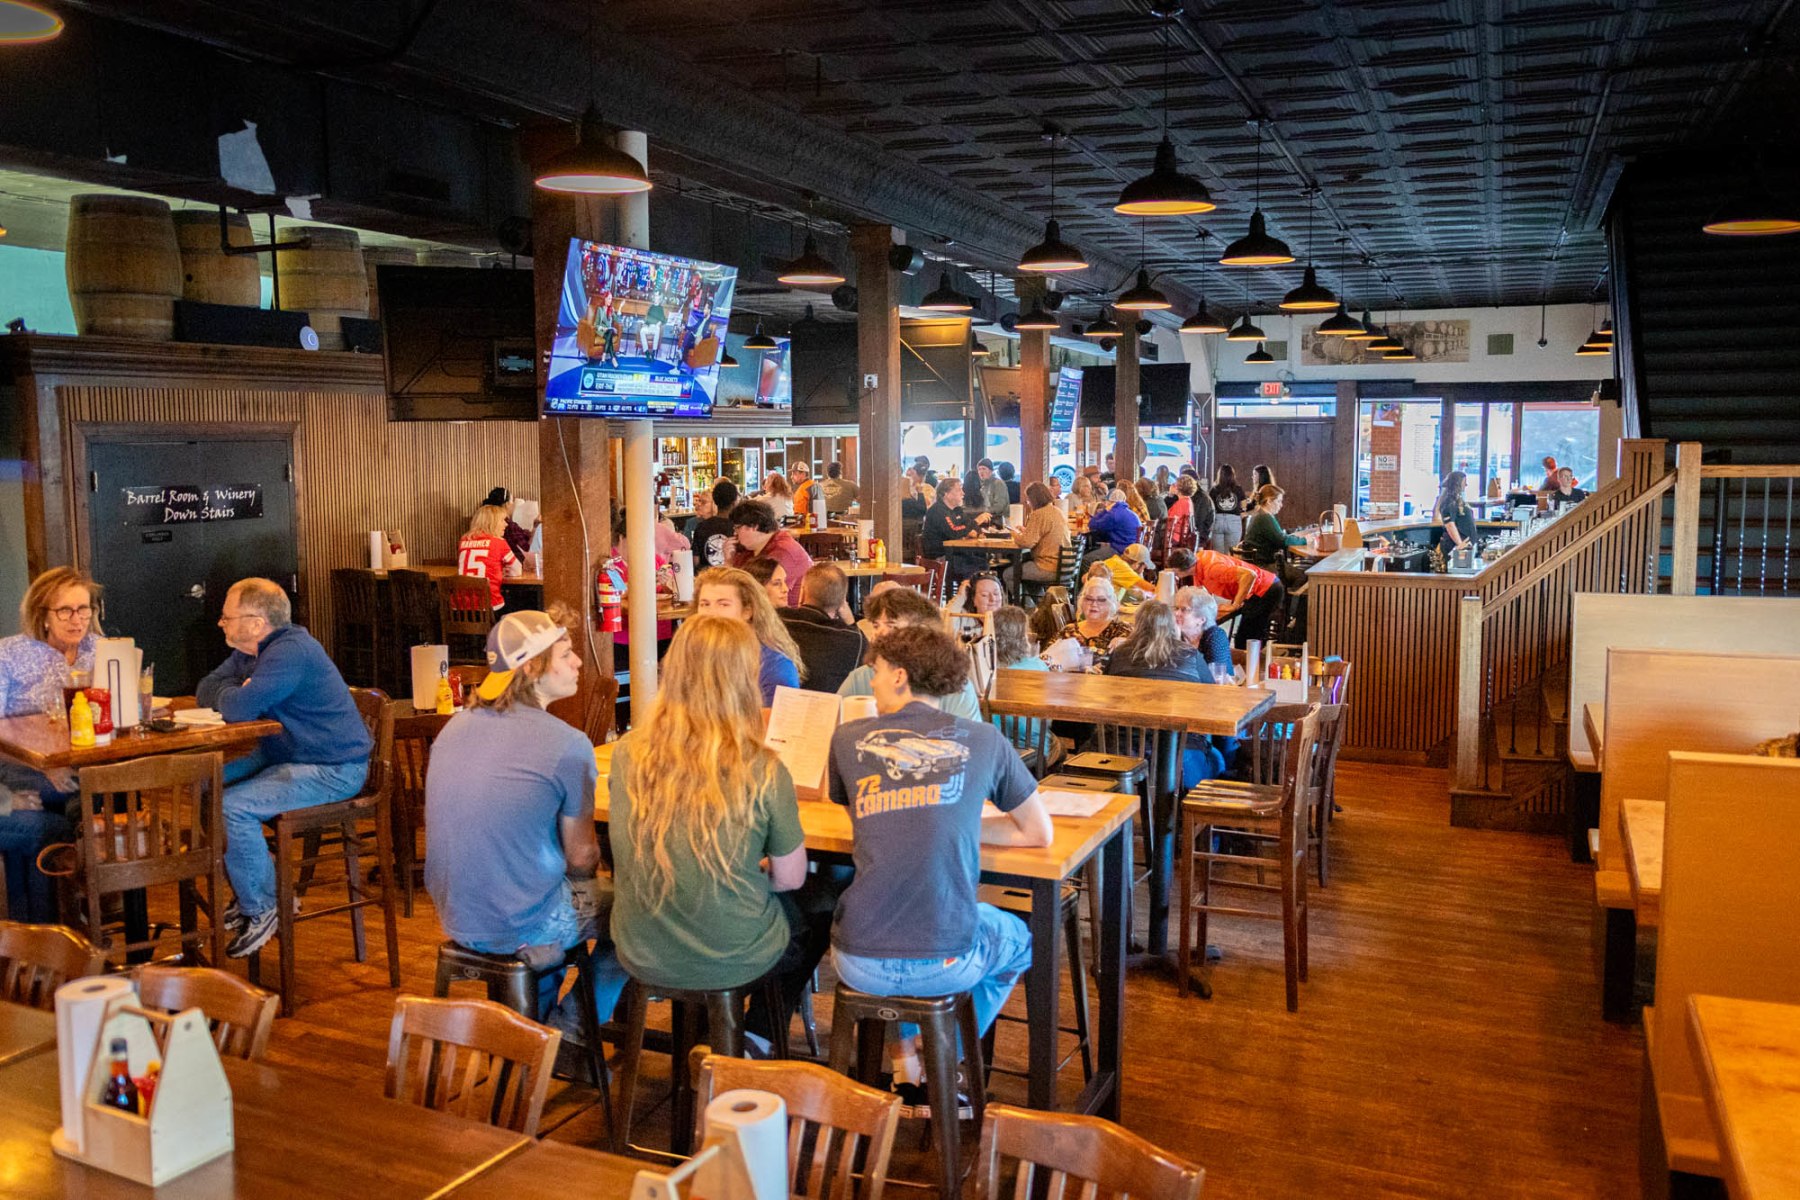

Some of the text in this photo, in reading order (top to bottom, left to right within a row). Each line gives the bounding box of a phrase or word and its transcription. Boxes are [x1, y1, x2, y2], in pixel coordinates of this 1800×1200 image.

[1265, 383, 1280, 395] EXIT
[127, 487, 256, 506] Barrel Room & Winery
[163, 505, 235, 523] Down Stairs
[459, 549, 489, 578] 15
[856, 774, 882, 798] 72
[855, 784, 941, 819] CAMARO
